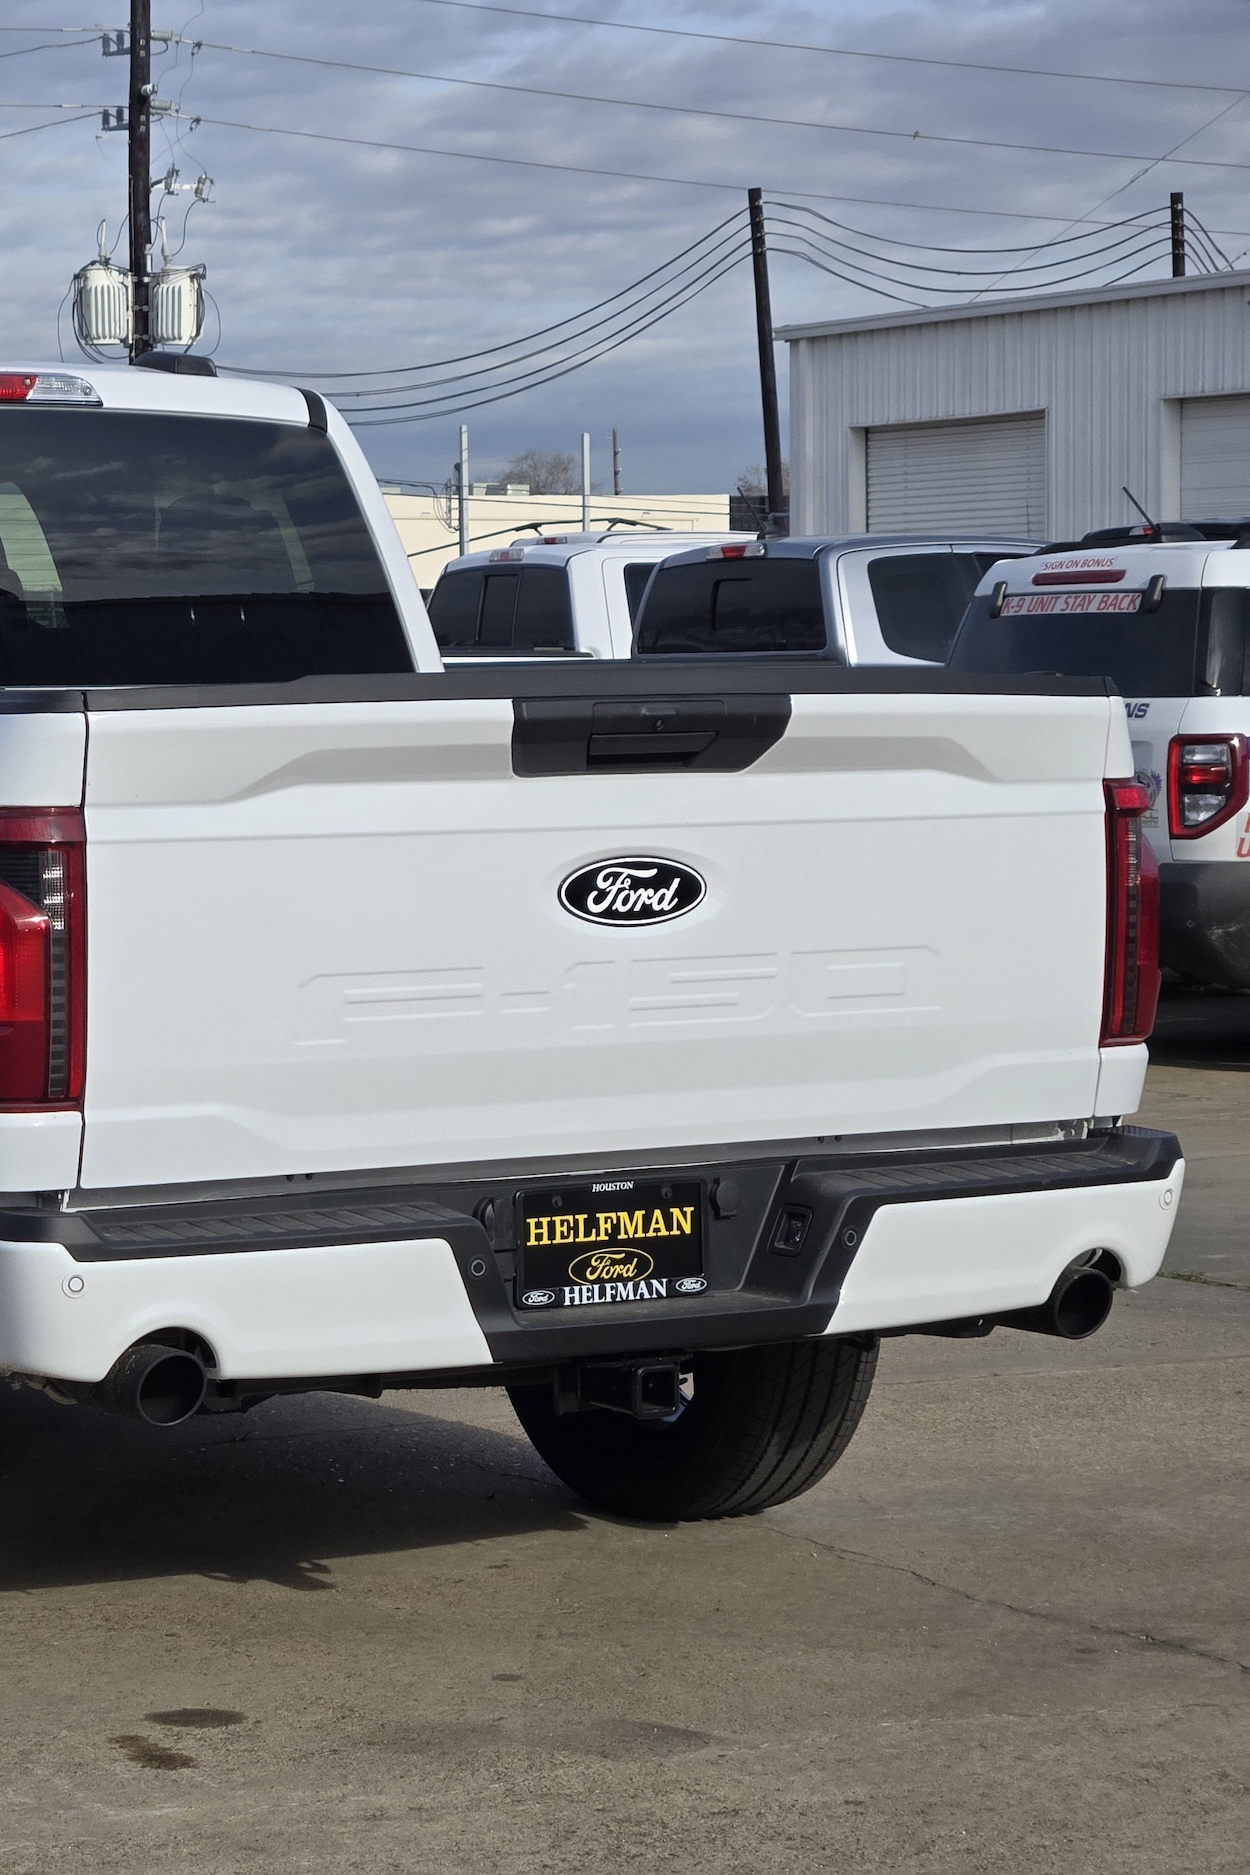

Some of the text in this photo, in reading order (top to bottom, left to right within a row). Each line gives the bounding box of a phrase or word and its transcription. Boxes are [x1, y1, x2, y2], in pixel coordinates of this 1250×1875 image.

[1066, 560, 1079, 569] ON
[1002, 594, 1141, 614] K-9 UNIT STAY BACK
[587, 867, 680, 915] Ford
[592, 1181, 634, 1193] HOUSTON
[526, 1207, 694, 1246] HELFMAN
[585, 1252, 638, 1280] Ford
[563, 1279, 668, 1306] HELFMAN
